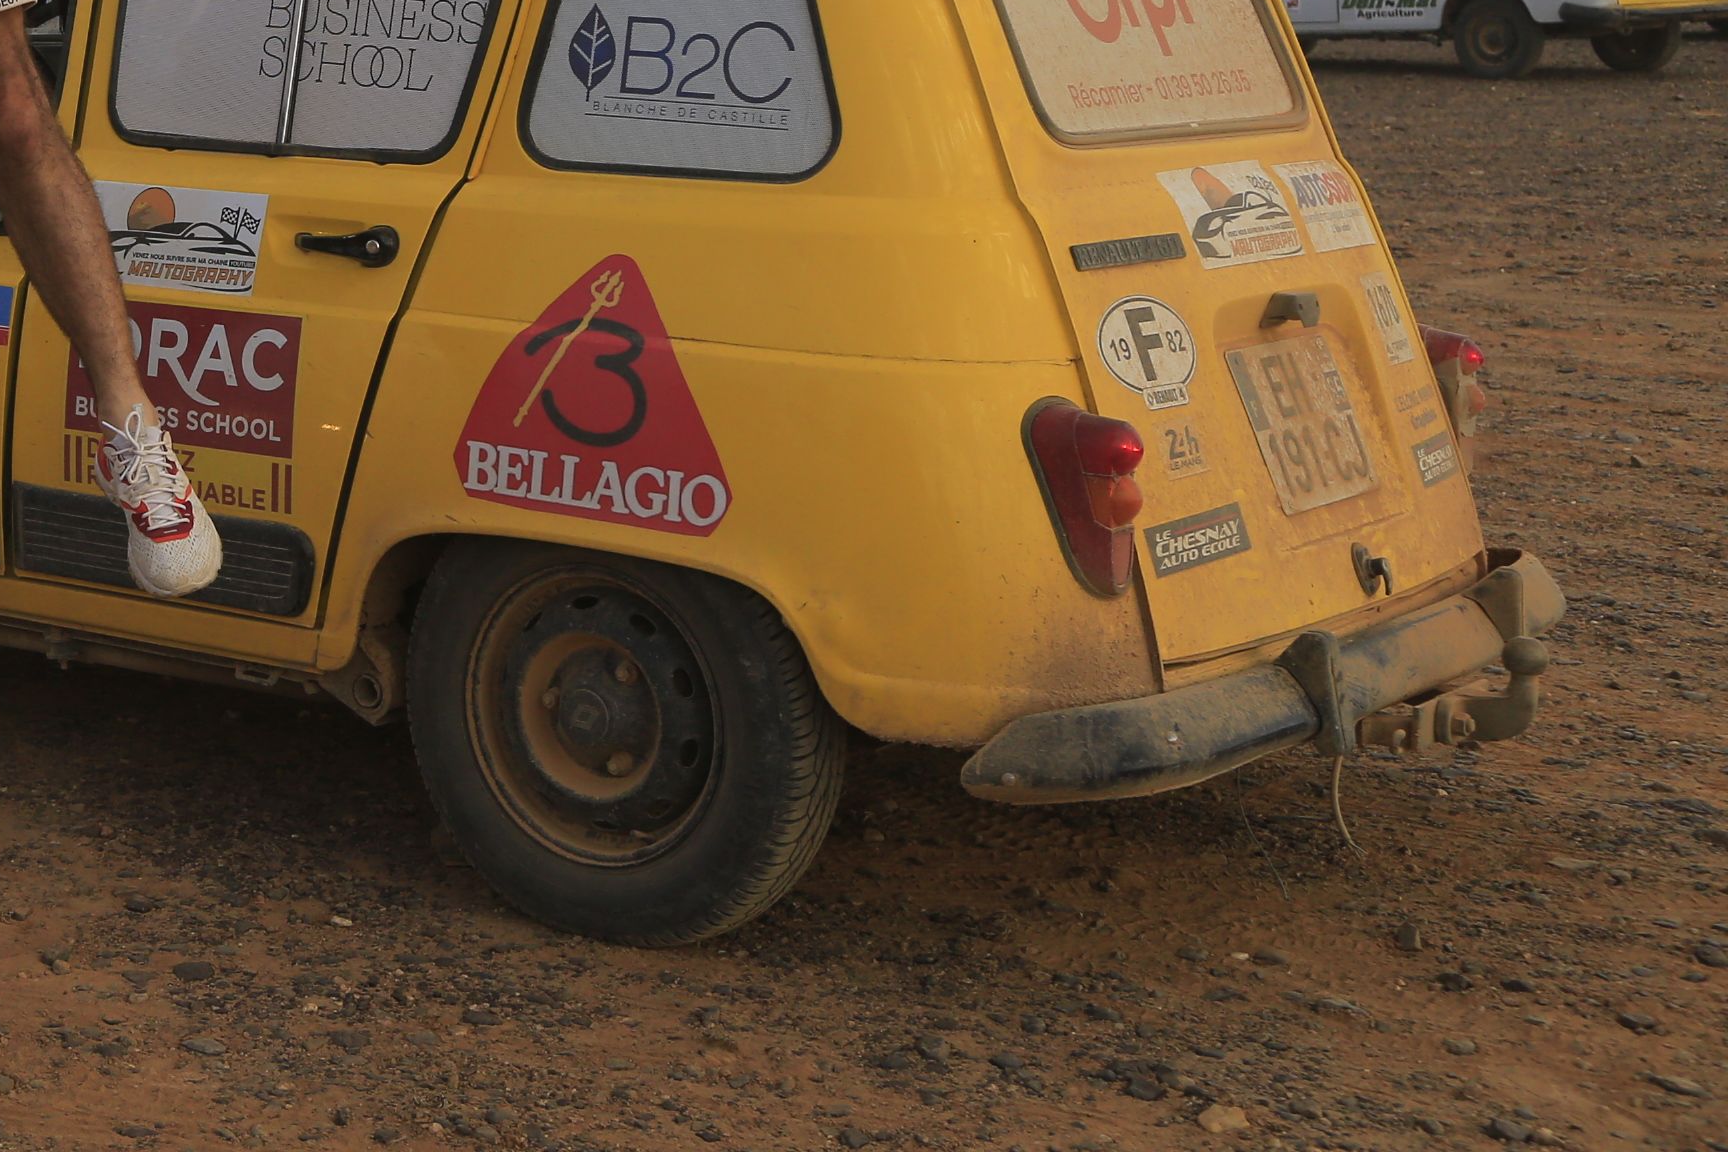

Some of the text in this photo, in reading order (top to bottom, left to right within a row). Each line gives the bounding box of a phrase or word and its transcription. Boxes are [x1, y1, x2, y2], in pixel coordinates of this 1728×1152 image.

[1357, 9, 1423, 19] Agriculture
[259, 36, 434, 92] SCHOOL
[620, 16, 795, 104] B2C
[1067, 79, 1144, 109] Récamier
[1155, 76, 1174, 100] 01
[1173, 74, 1193, 98] 39
[1191, 73, 1212, 96] 50
[1212, 71, 1232, 95] 26
[1231, 69, 1252, 92] 35
[592, 101, 789, 125] BLANCHE DE CASTILLE
[127, 260, 254, 287] MAUTOGRAPHY
[1109, 306, 1187, 382] 19 F 82
[1154, 387, 1186, 405] RENAULT 4
[186, 411, 281, 442] SCHOOL
[463, 440, 727, 527] BELLAGIO
[1155, 518, 1240, 558] CHESNAY
[1156, 529, 1172, 542] LE
[1159, 535, 1241, 570] AUTO ECOLE
